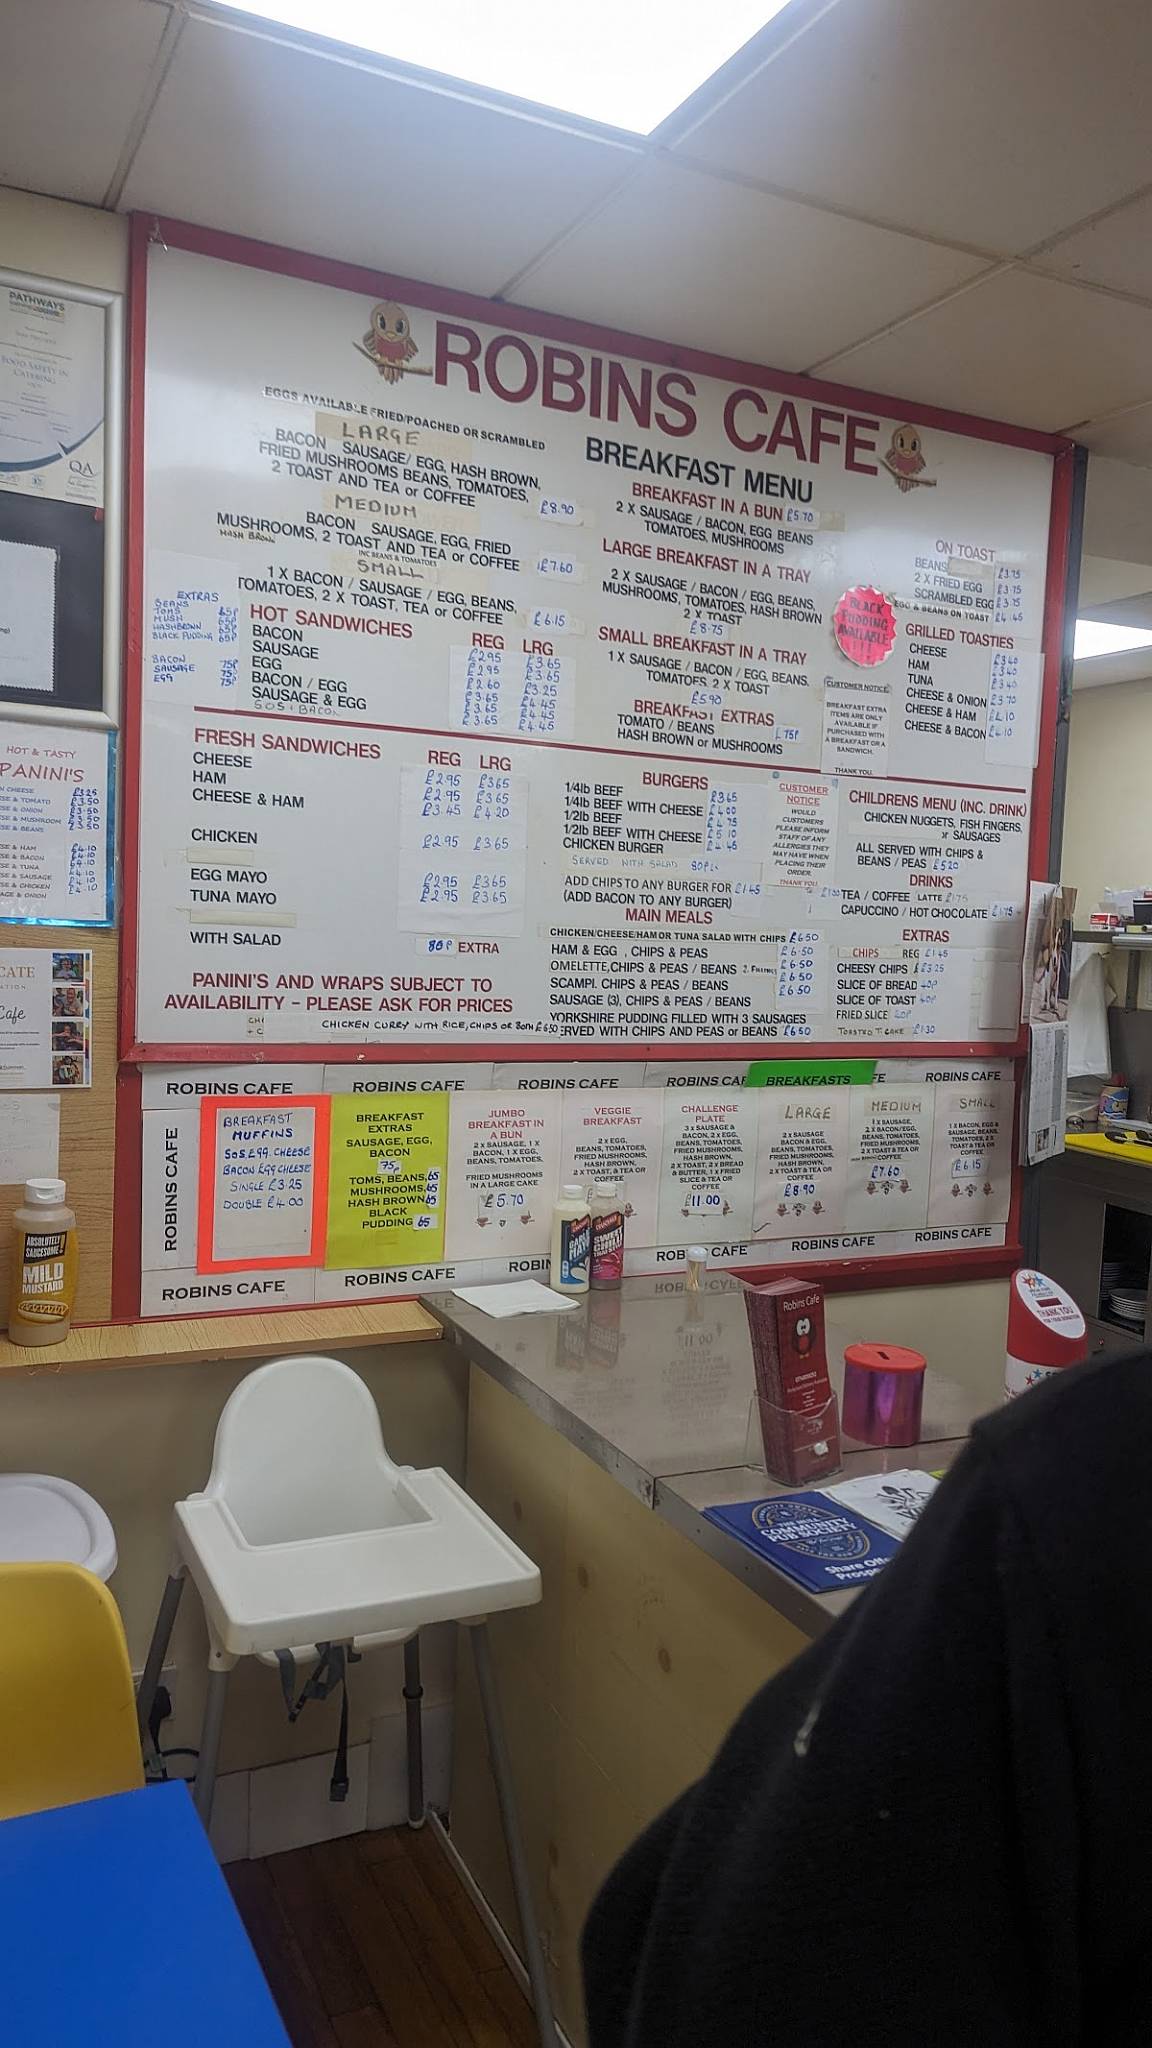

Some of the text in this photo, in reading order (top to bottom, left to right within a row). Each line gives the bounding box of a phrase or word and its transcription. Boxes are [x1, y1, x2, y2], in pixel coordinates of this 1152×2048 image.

[9, 290, 65, 311] PATHWAYS
[435, 320, 880, 476] ROBINS CAFE
[265, 386, 299, 401] EGGS
[463, 427, 479, 439] OR
[479, 430, 546, 450] SCRAMBLED
[342, 421, 420, 446] LARGE
[276, 429, 327, 448] BACON
[416, 456, 446, 474] EGG,
[451, 462, 486, 480] HASH
[490, 469, 541, 491] BROWN,
[259, 440, 529, 502] FRIED MUSHROOMS BEANS, TOMATOES,
[586, 437, 813, 503] BREAKFAST MENU
[271, 460, 477, 508] 2 TOAST AND TEA or COFFEE
[541, 500, 574, 515] £8.90
[632, 482, 783, 521] BREAKFAST IN A BUN
[644, 520, 785, 555] TOMATOES, MUSHROOMS
[936, 540, 995, 562] ON TOAST
[602, 538, 811, 584] LARGE BREAKFAST IN A TRAY
[915, 557, 949, 572] BEANS
[177, 591, 219, 602] EXTRAS
[914, 589, 995, 610] SCRAMBLED EGG
[251, 604, 413, 639] HOT SANDWICHES
[472, 632, 554, 656] REG LRG
[906, 623, 1014, 649] GRILLED TOASTIES
[599, 626, 807, 666] SMALL BREAKFAST IN A TRAY
[909, 643, 947, 658] CHEESE
[906, 687, 987, 708] CHEESE & ONION
[195, 728, 381, 759] FRESH SANDWICHES
[6, 746, 76, 759] HOT & TASTY
[0, 762, 84, 782] PANINI'S
[564, 782, 624, 796] 1/4lb BEEF
[642, 772, 709, 790] BURGERS
[779, 783, 829, 795] CUSTOMER
[192, 788, 304, 808] CHEESE & HAM
[849, 790, 1027, 817] CHILDRENS MENU (INC. DRINK)
[191, 829, 258, 845] CHICKEN
[563, 838, 664, 854] CHICKEN BURGER
[191, 868, 267, 884] EGG MAYO
[909, 875, 953, 888] DRINKS
[190, 889, 277, 906] TUNA MAYO
[917, 894, 942, 902] LATTE
[625, 908, 713, 924] MAIN MEALS
[909, 907, 988, 919] HOT CHOCOLATE
[190, 931, 281, 946] WITH SALAD
[902, 929, 950, 942] EXTRAS
[852, 947, 879, 958] CHIPS
[193, 973, 493, 992] PANINI'S AND WRAPS SUBJECT TO
[837, 980, 918, 990] SLICE OF BREAD
[321, 1020, 409, 1031] CHICKEN CURRY
[549, 1012, 806, 1025] YORKSHIRE PUDDING FILLED WITH 3 SAUSAGES
[766, 1075, 851, 1086] BREAKFASTS
[166, 1083, 293, 1095] ROBINS CAFE
[489, 1109, 525, 1118] JUMBO
[594, 1107, 631, 1115] VEGGIE
[681, 1105, 738, 1113] CHALLENGE
[872, 1101, 921, 1112] MEDIUM
[224, 1113, 293, 1128] BREAKFAST
[356, 1113, 424, 1122] BREAKFAST
[232, 1128, 293, 1140] MUFFINS
[368, 1124, 412, 1133] EXTRAS
[230, 1181, 264, 1192] SINGLE
[484, 1194, 524, 1208] £5.70
[23, 1262, 64, 1283] MILD
[344, 1268, 456, 1287] ROBINS CAFE
[22, 1280, 64, 1294] MUSTARD
[783, 1294, 820, 1311] Robins Cafe
[761, 1518, 848, 1537] COMMUNITY
[767, 1523, 857, 1543] PUB SOCIETY
[825, 1562, 861, 1574] Share
